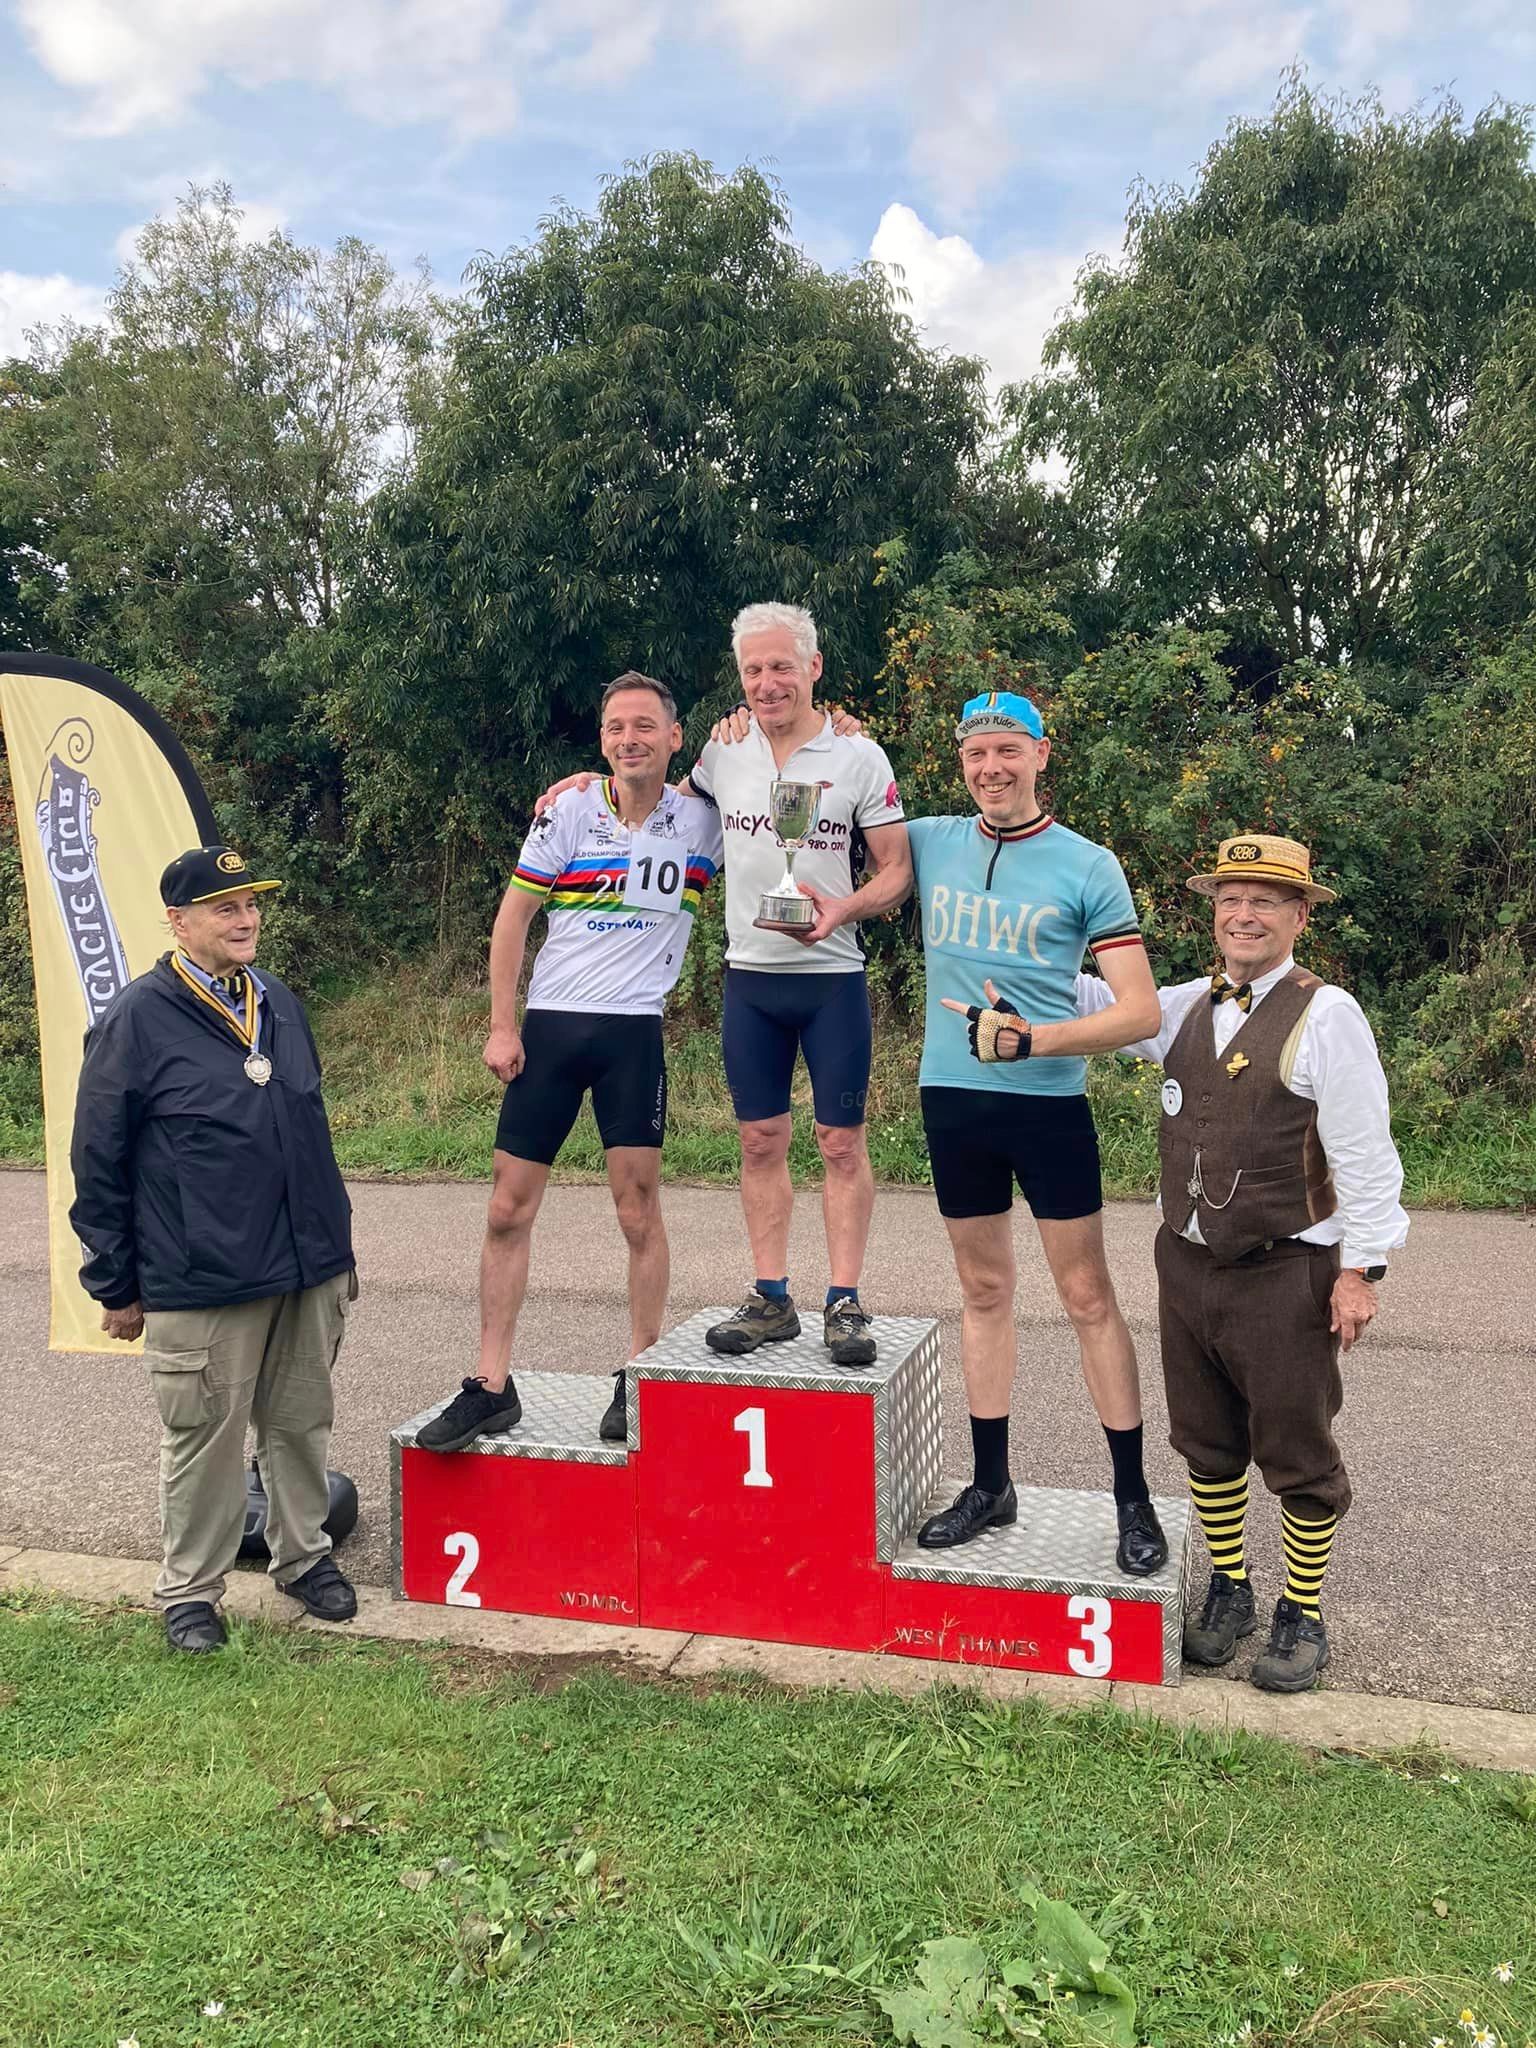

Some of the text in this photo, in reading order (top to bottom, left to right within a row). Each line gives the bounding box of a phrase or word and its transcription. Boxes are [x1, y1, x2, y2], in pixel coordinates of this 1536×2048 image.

[959, 716, 1016, 734] Ordinary Rider
[808, 839, 828, 850] 980
[637, 856, 680, 895] 10
[927, 885, 1060, 965] BHWC
[734, 1407, 773, 1487] 1
[443, 1531, 481, 1608] 2
[559, 1591, 634, 1614] WDMBC
[894, 1627, 1040, 1657] WEST THAMES
[1067, 1595, 1112, 1677] 3
